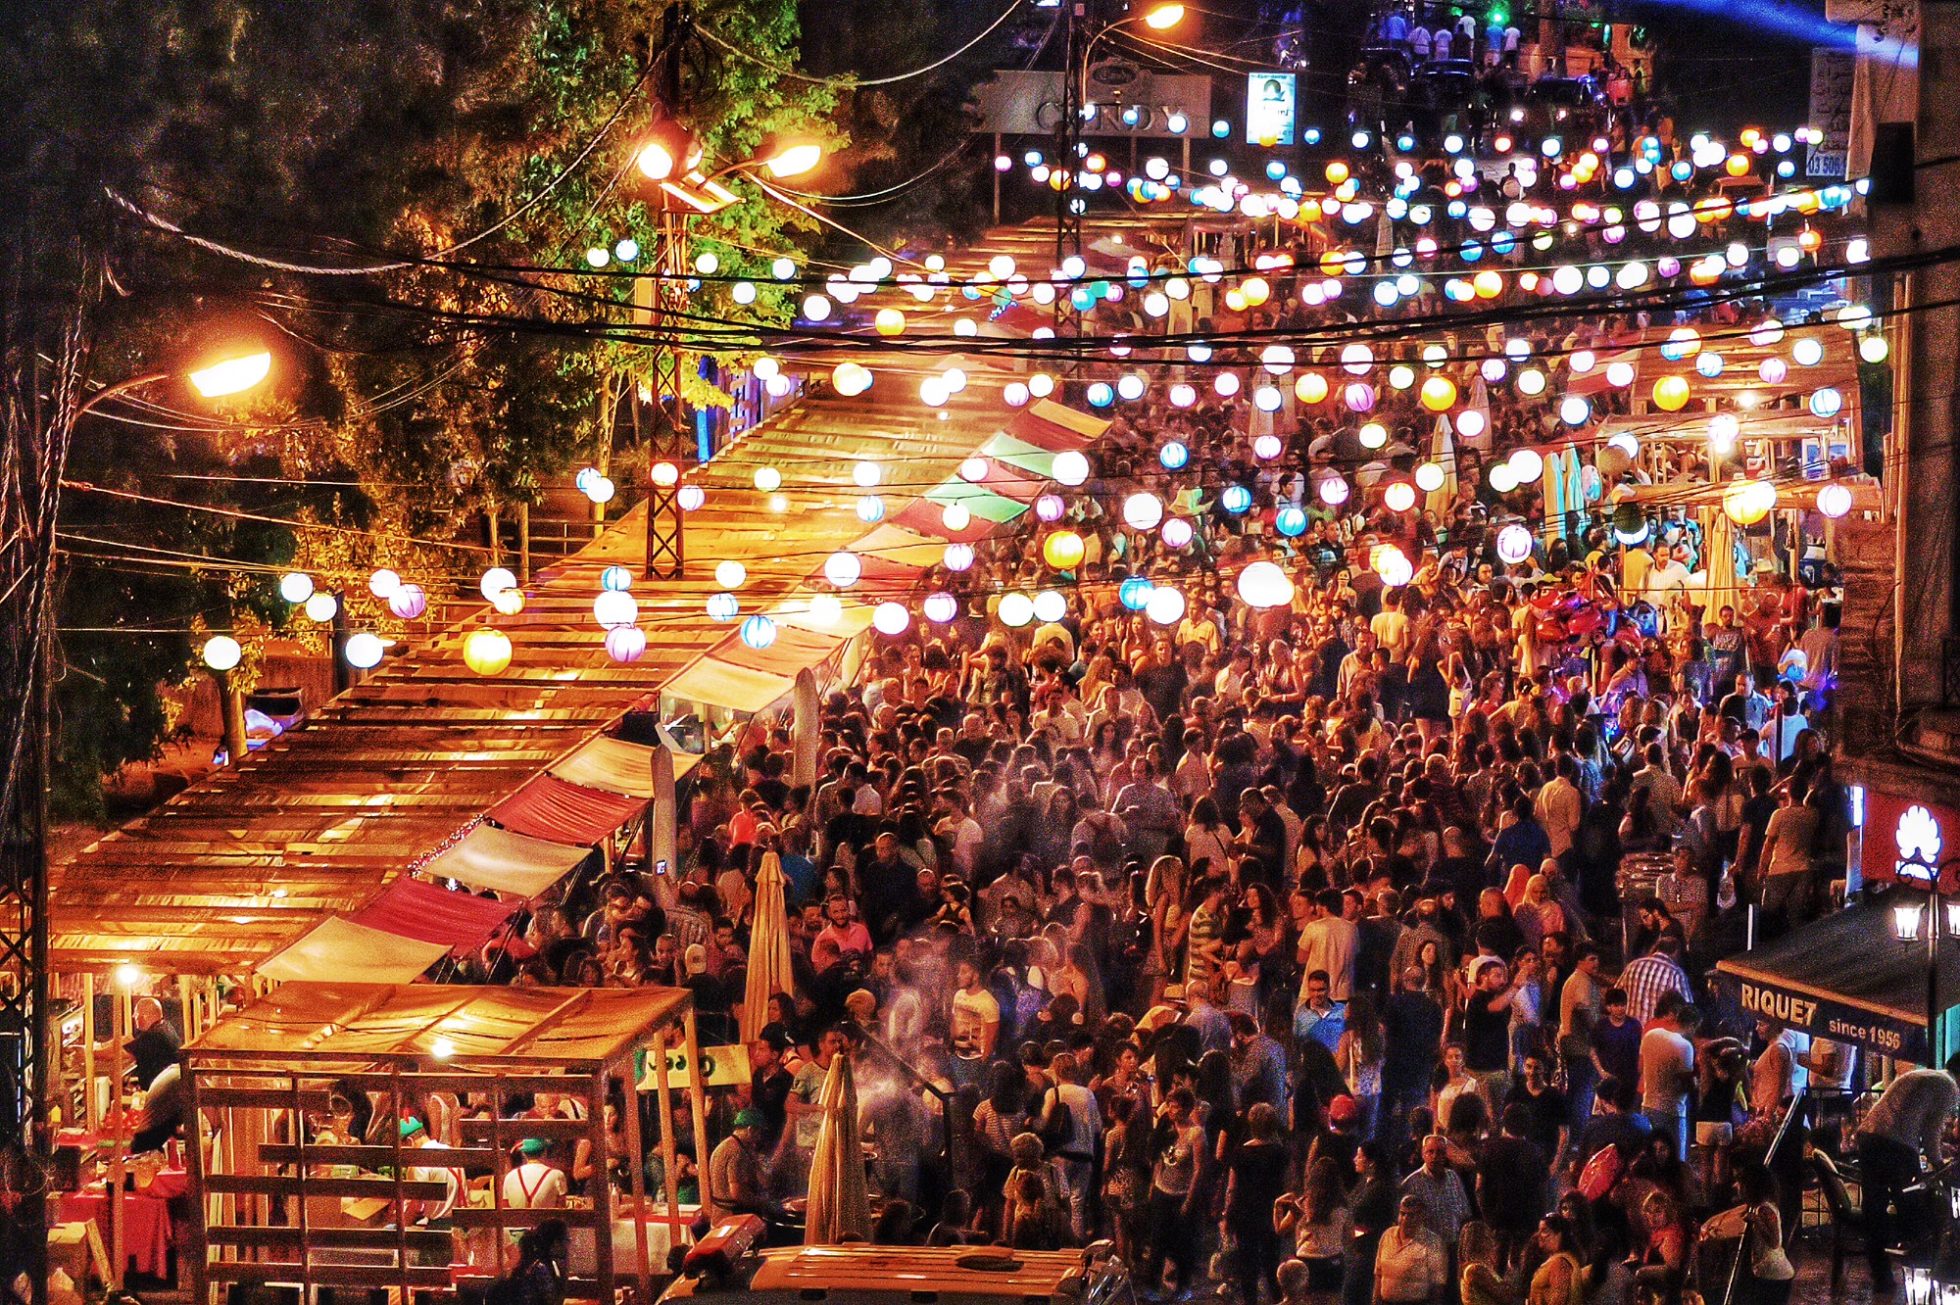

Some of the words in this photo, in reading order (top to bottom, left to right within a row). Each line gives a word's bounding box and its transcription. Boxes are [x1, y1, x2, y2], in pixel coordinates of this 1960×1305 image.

[1741, 983, 1816, 1027] RIQUET
[1828, 1018, 1867, 1040] since
[1869, 1026, 1901, 1050] 1956
